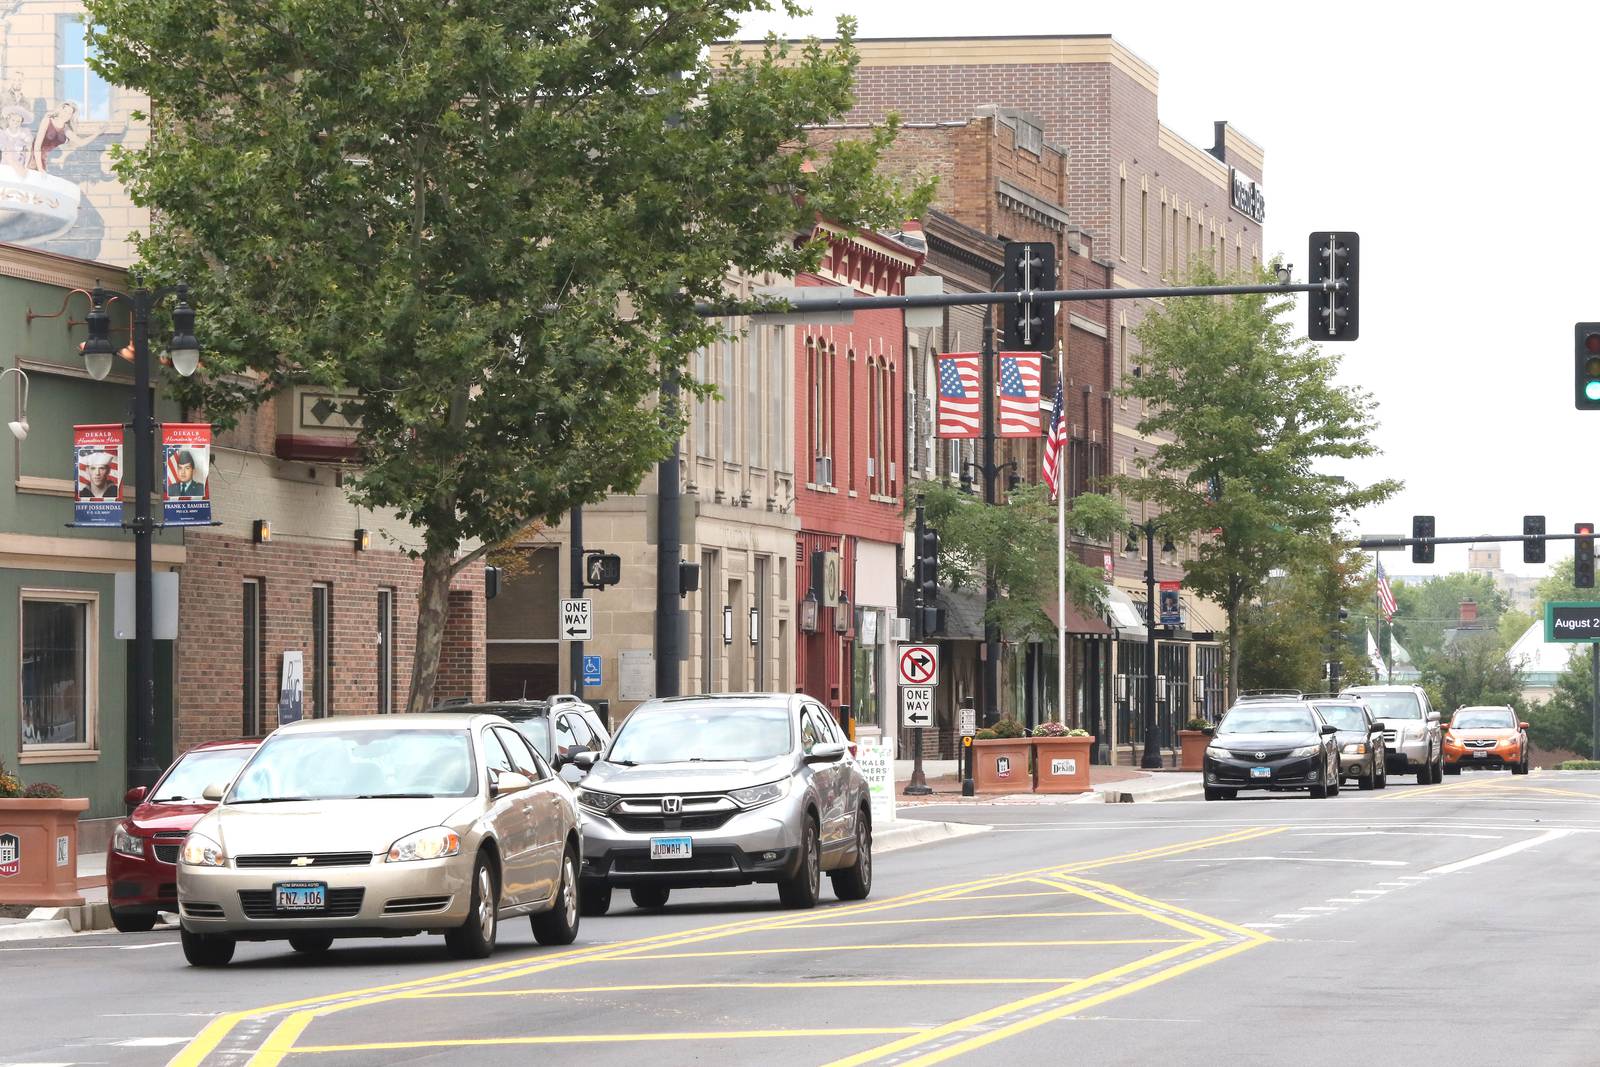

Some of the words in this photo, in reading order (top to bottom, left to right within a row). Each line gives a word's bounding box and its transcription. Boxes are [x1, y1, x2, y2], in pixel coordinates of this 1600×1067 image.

[565, 602, 587, 613] ONE
[565, 615, 588, 624] WAY
[1555, 618, 1591, 630] August
[906, 690, 929, 700] ONE
[906, 702, 930, 711] WAY
[280, 892, 298, 904] FNZ
[304, 892, 321, 904] 106
